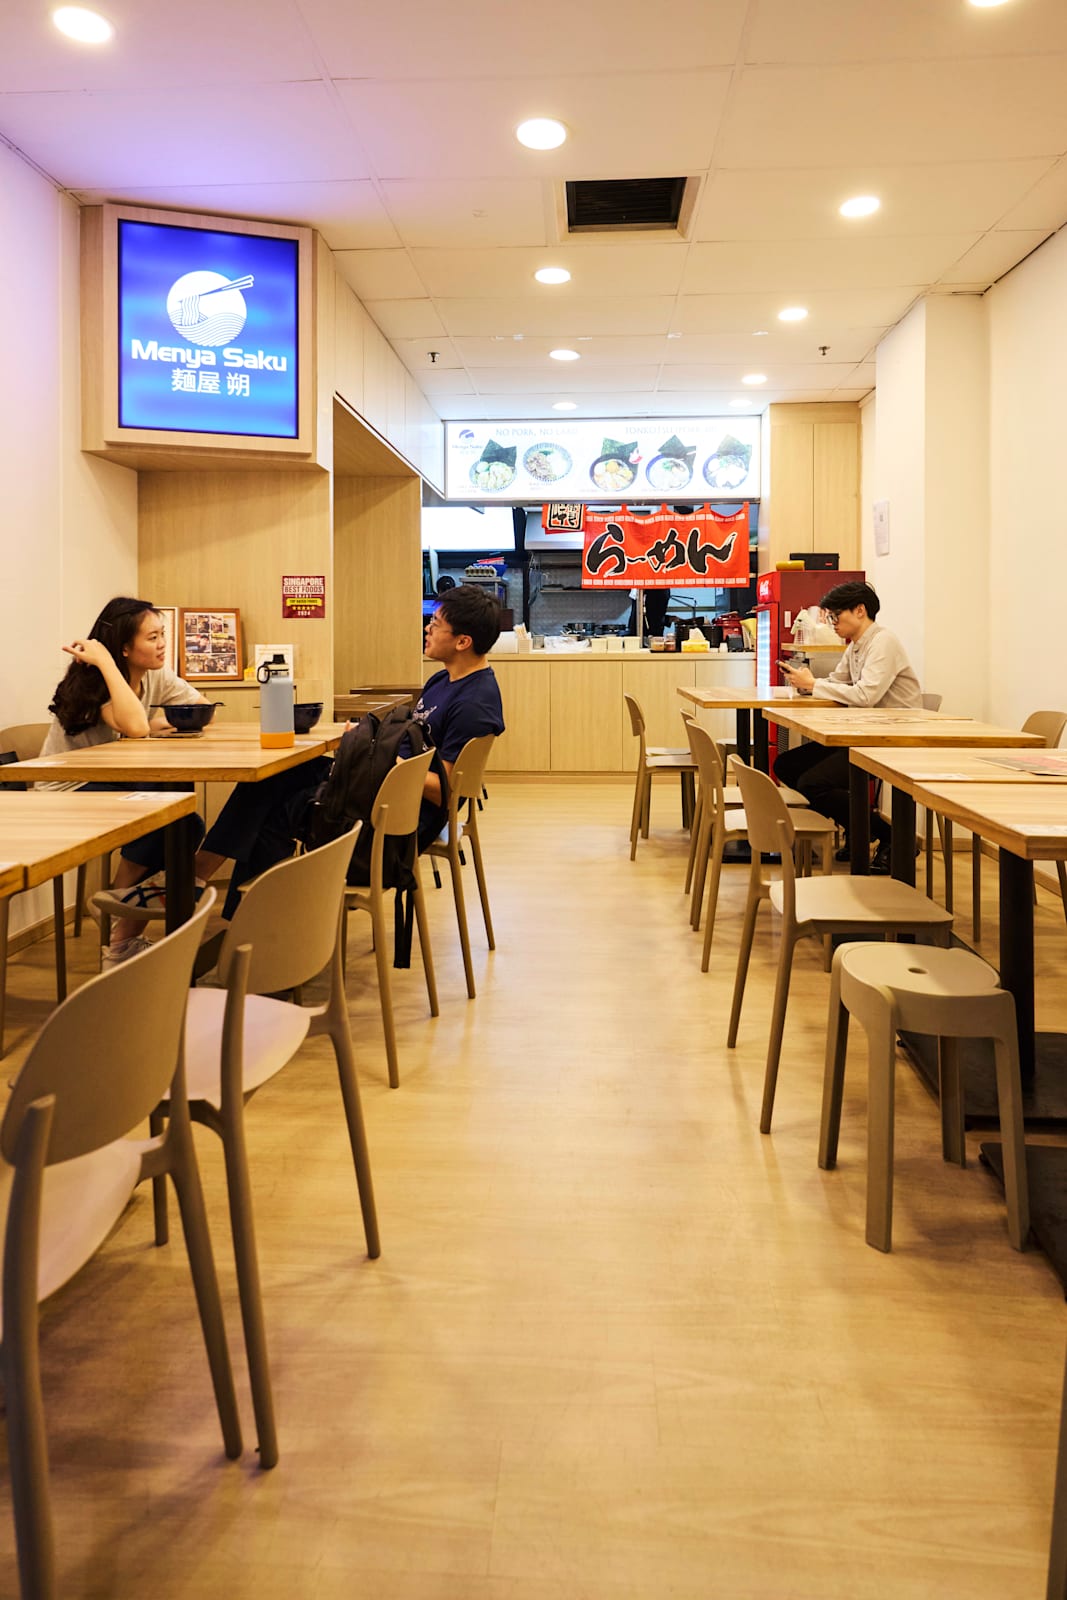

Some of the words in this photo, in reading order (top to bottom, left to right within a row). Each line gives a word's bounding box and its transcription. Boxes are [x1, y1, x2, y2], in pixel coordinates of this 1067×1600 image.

[131, 339, 216, 368] Menya
[222, 347, 287, 371] Saku
[496, 428, 509, 436] NO
[540, 428, 553, 436] NO
[586, 523, 737, 577] らーめん
[283, 577, 324, 586] SINGAPORE
